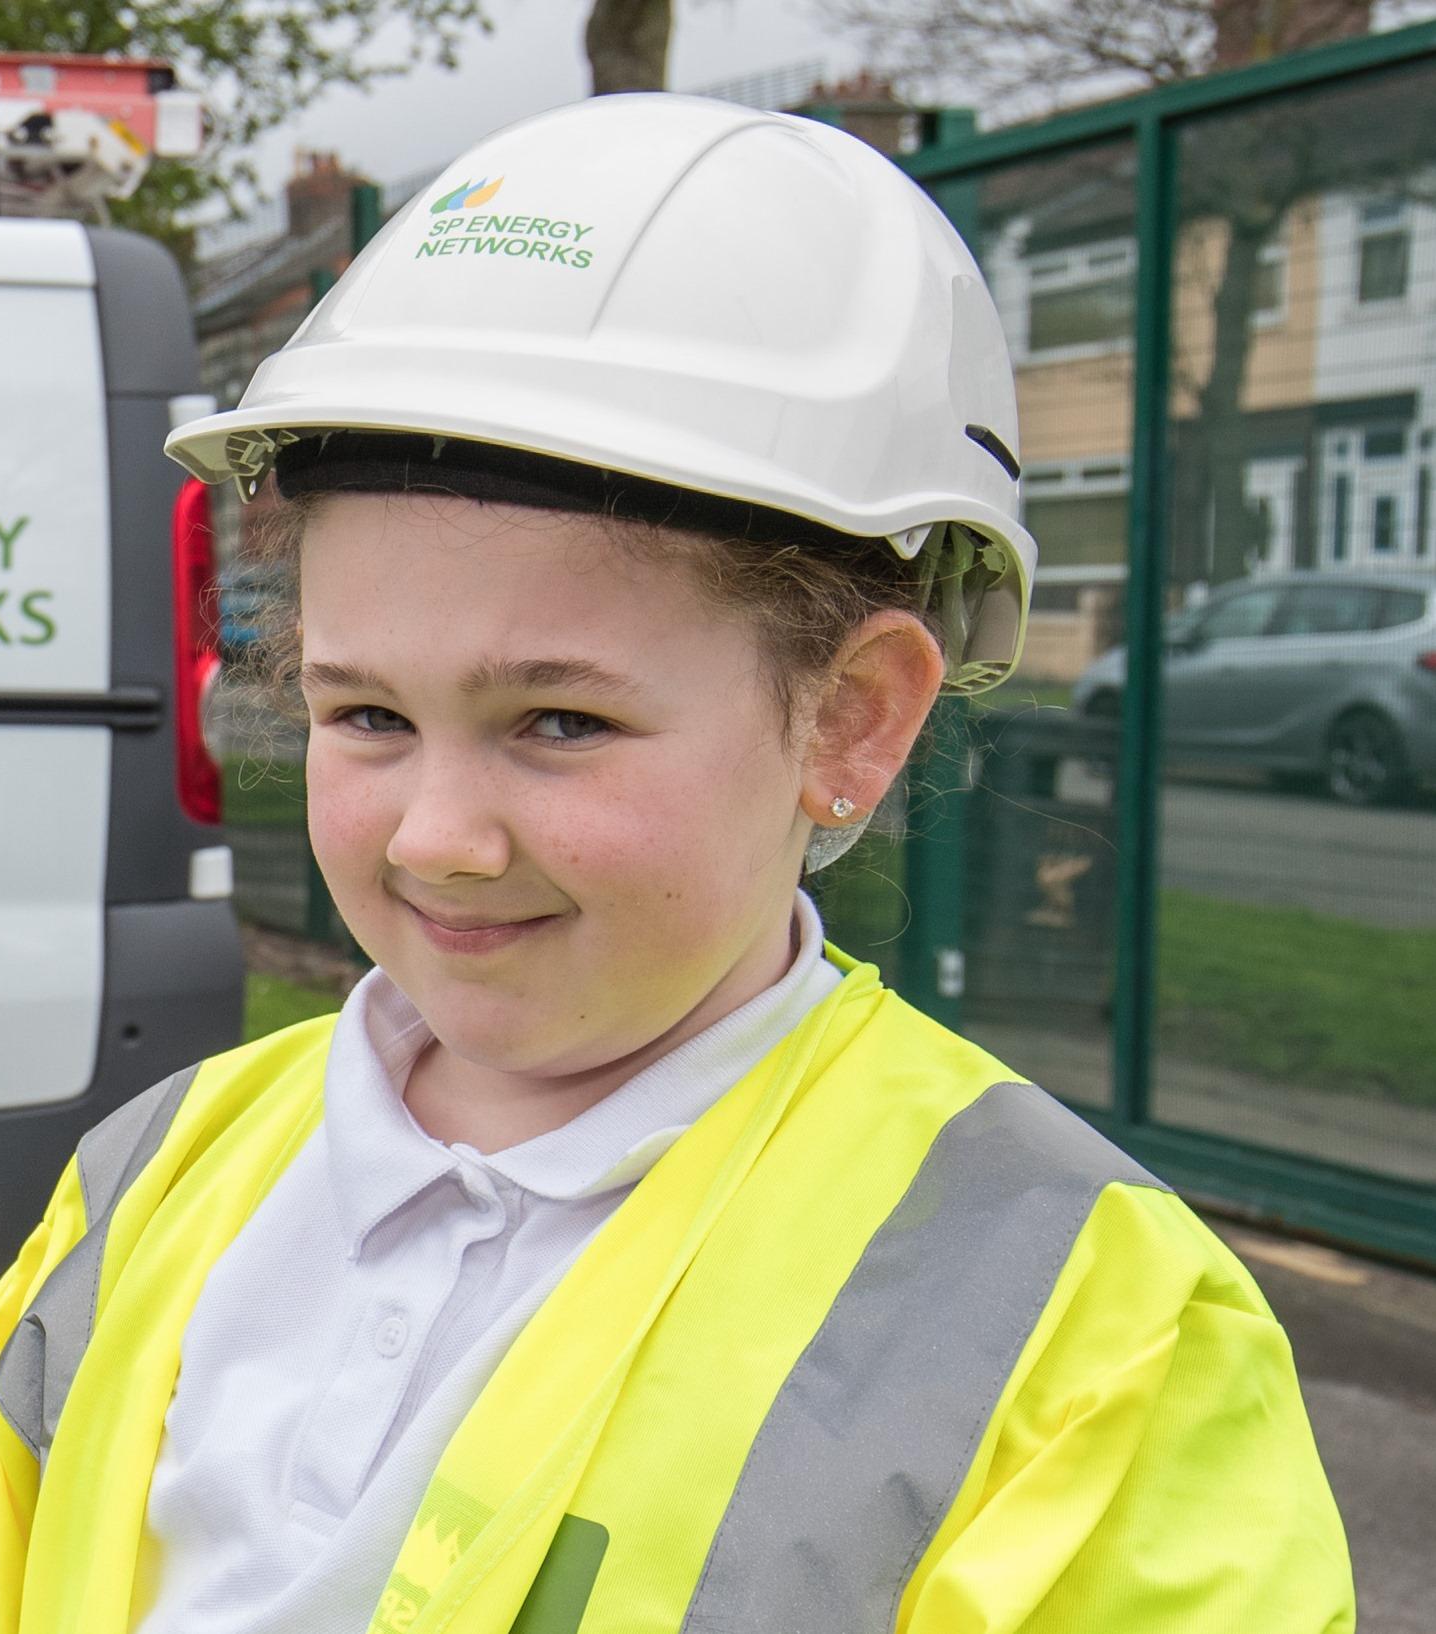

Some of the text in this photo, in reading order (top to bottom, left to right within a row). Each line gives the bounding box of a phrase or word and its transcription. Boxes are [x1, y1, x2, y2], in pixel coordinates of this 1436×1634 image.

[429, 215, 594, 242] SP ENERGY
[415, 237, 593, 268] NETWORKS
